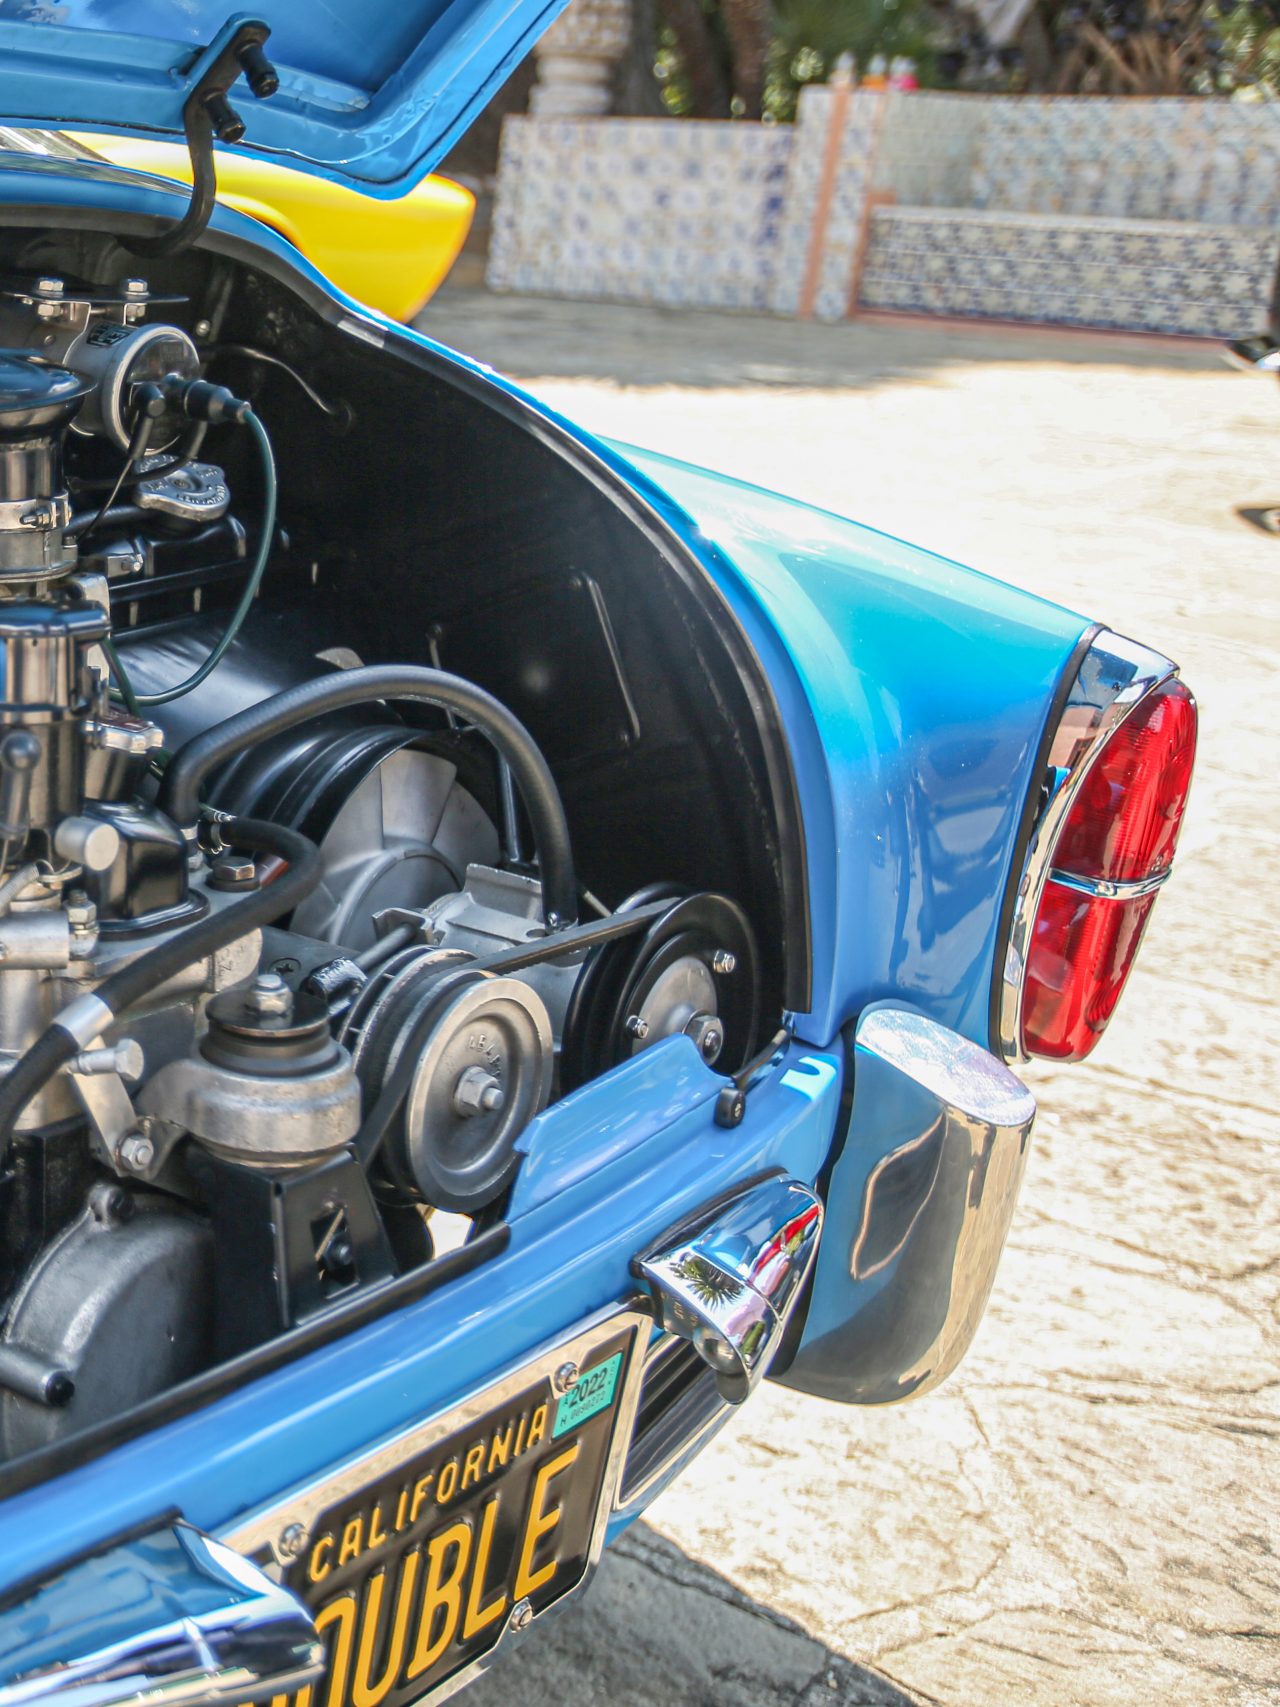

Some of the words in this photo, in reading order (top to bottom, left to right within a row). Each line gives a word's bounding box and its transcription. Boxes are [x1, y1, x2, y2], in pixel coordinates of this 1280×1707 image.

[569, 1367, 608, 1408] 2022
[237, 1444, 580, 1707] OUBLE
[310, 1404, 548, 1582] CALIFORNIA
